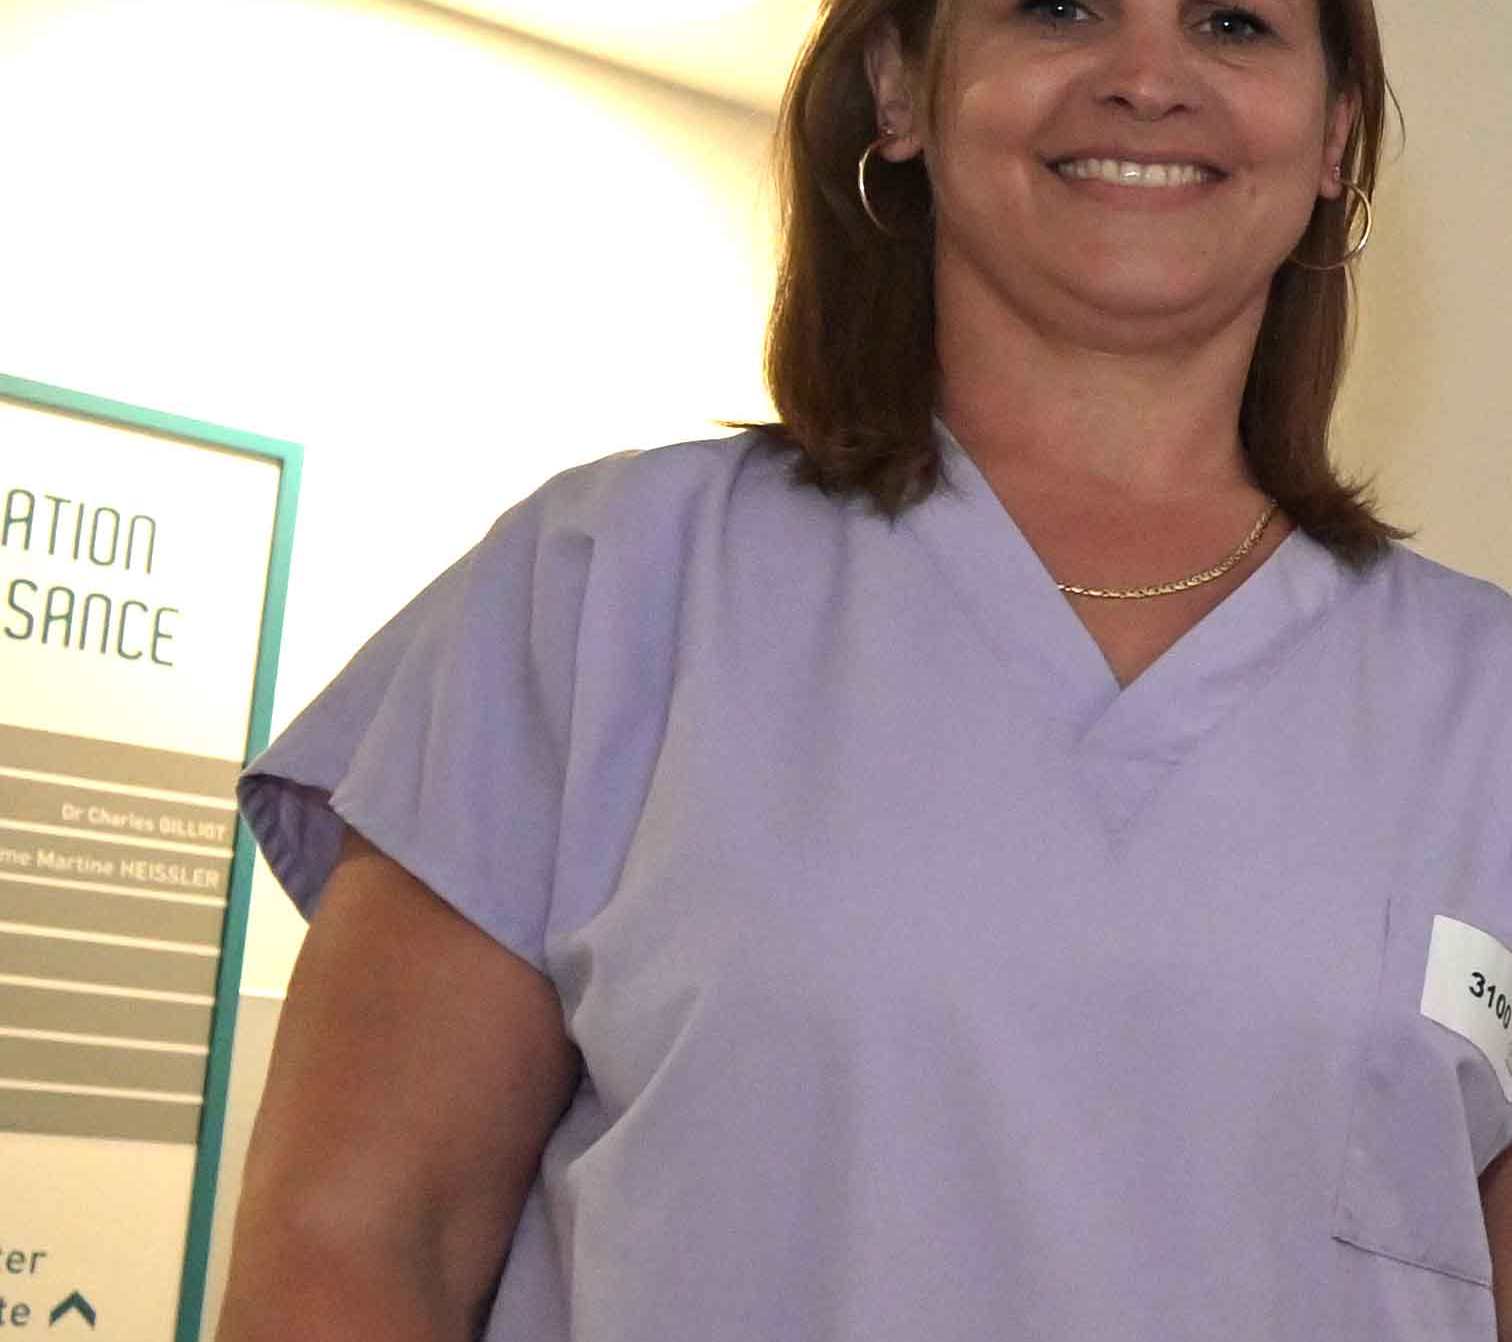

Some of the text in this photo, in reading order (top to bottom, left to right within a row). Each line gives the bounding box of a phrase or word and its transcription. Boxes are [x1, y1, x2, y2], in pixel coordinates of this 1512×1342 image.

[1, 488, 156, 575] ATION
[4, 578, 179, 667] SANCE
[61, 801, 83, 821] Dr
[88, 804, 154, 833] Charles
[37, 849, 115, 876] Martine
[1468, 971, 1512, 1029] 3100
[0, 1246, 47, 1274] er
